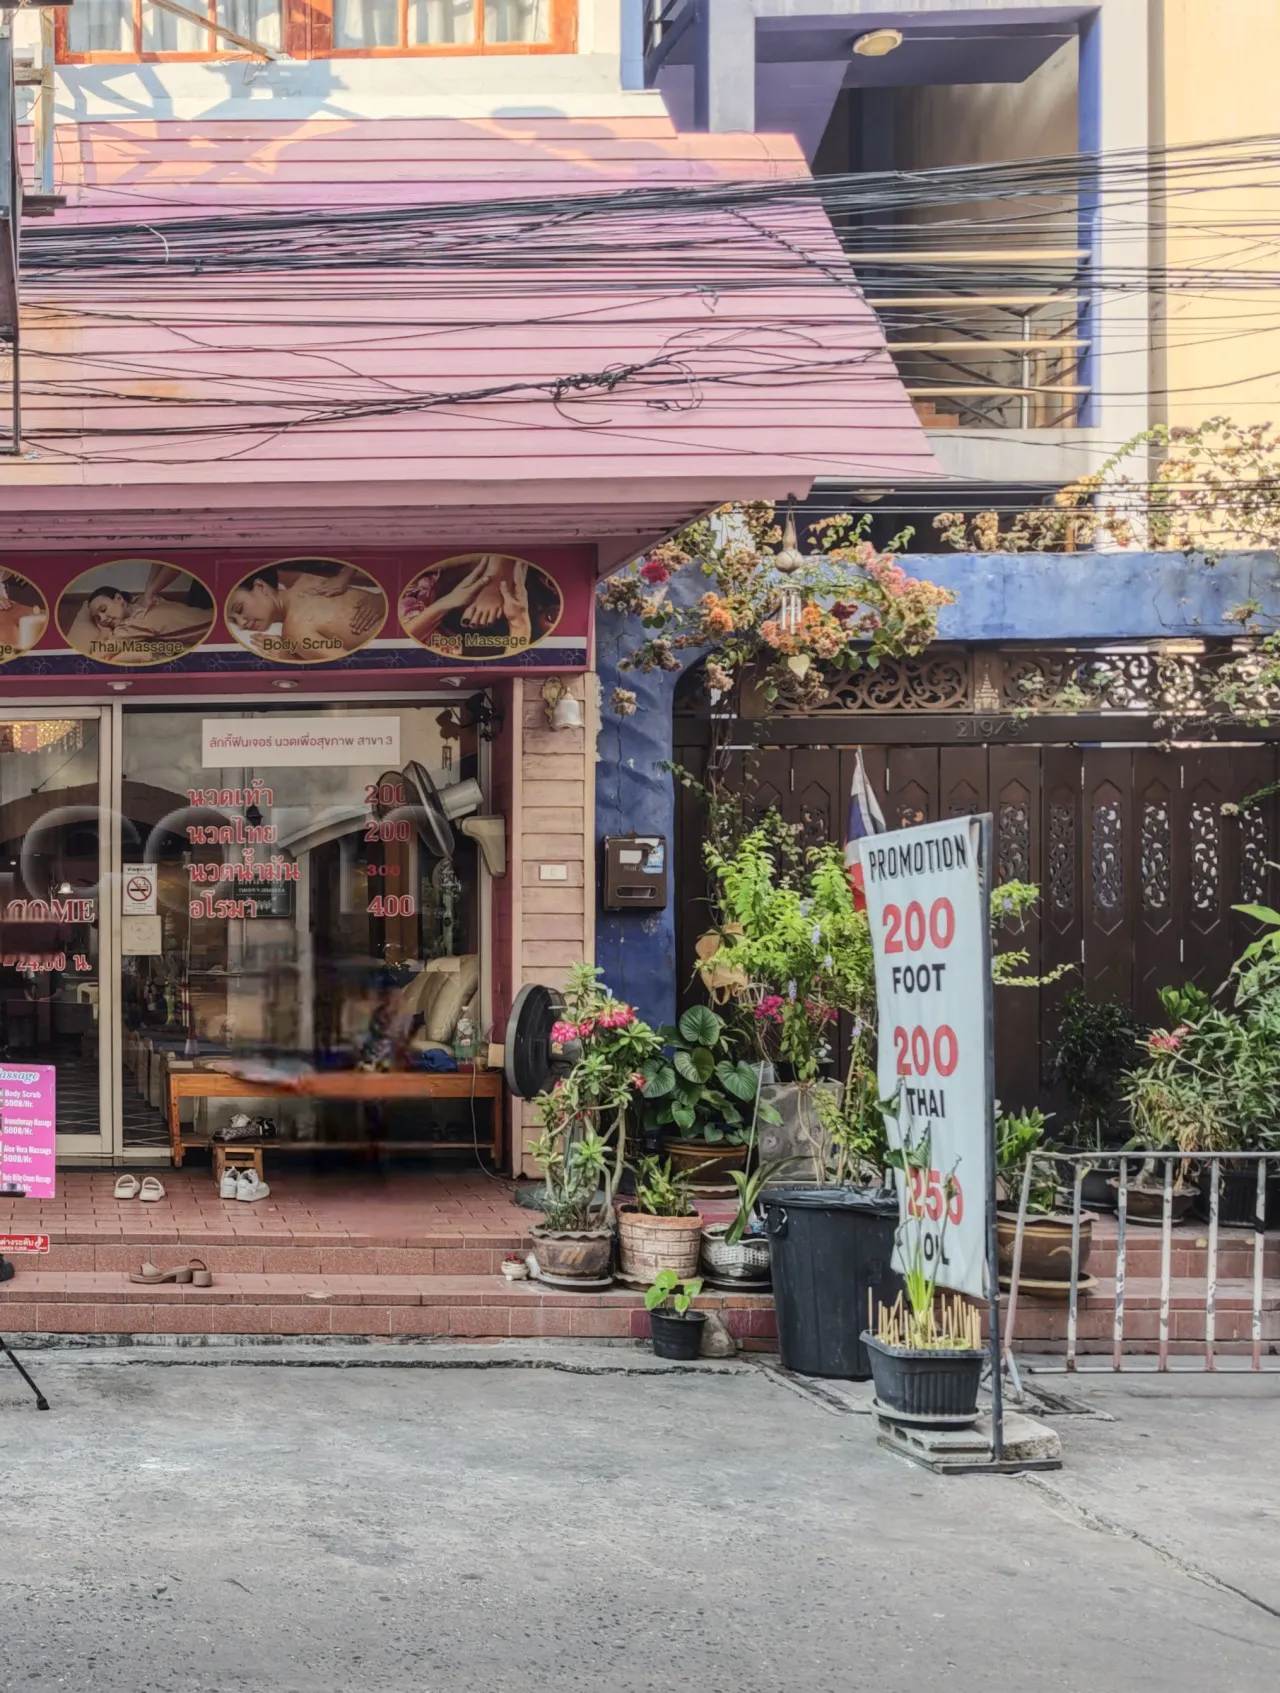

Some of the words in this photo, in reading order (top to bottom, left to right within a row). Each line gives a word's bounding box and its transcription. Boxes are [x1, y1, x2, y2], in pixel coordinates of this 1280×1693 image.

[89, 640, 119, 653] Thai
[122, 640, 183, 655] Massage
[263, 638, 297, 654] Body
[302, 637, 343, 650] Scrub
[431, 634, 463, 647] Foot
[465, 634, 527, 649] Massage
[275, 731, 355, 749] นวดเพื่อสุขภาพ
[357, 736, 384, 746] สาขา
[385, 735, 393, 745] 3
[186, 779, 274, 808] นวดเท้า
[364, 782, 408, 806] 200
[186, 815, 278, 845] นวดไทย
[364, 819, 412, 842] 200
[187, 848, 302, 883] นวดน้ำมัน
[366, 863, 402, 877] 300
[868, 834, 969, 883] PROMOTION
[188, 889, 258, 919] อโรมา
[366, 894, 416, 917] 400
[882, 896, 956, 955] 200
[892, 962, 946, 994] FOOT
[893, 1023, 959, 1077] 200
[4, 1089, 21, 1100] Body
[22, 1090, 42, 1099] Scrub
[906, 1088, 946, 1118] THAI
[907, 1167, 964, 1226] 250
